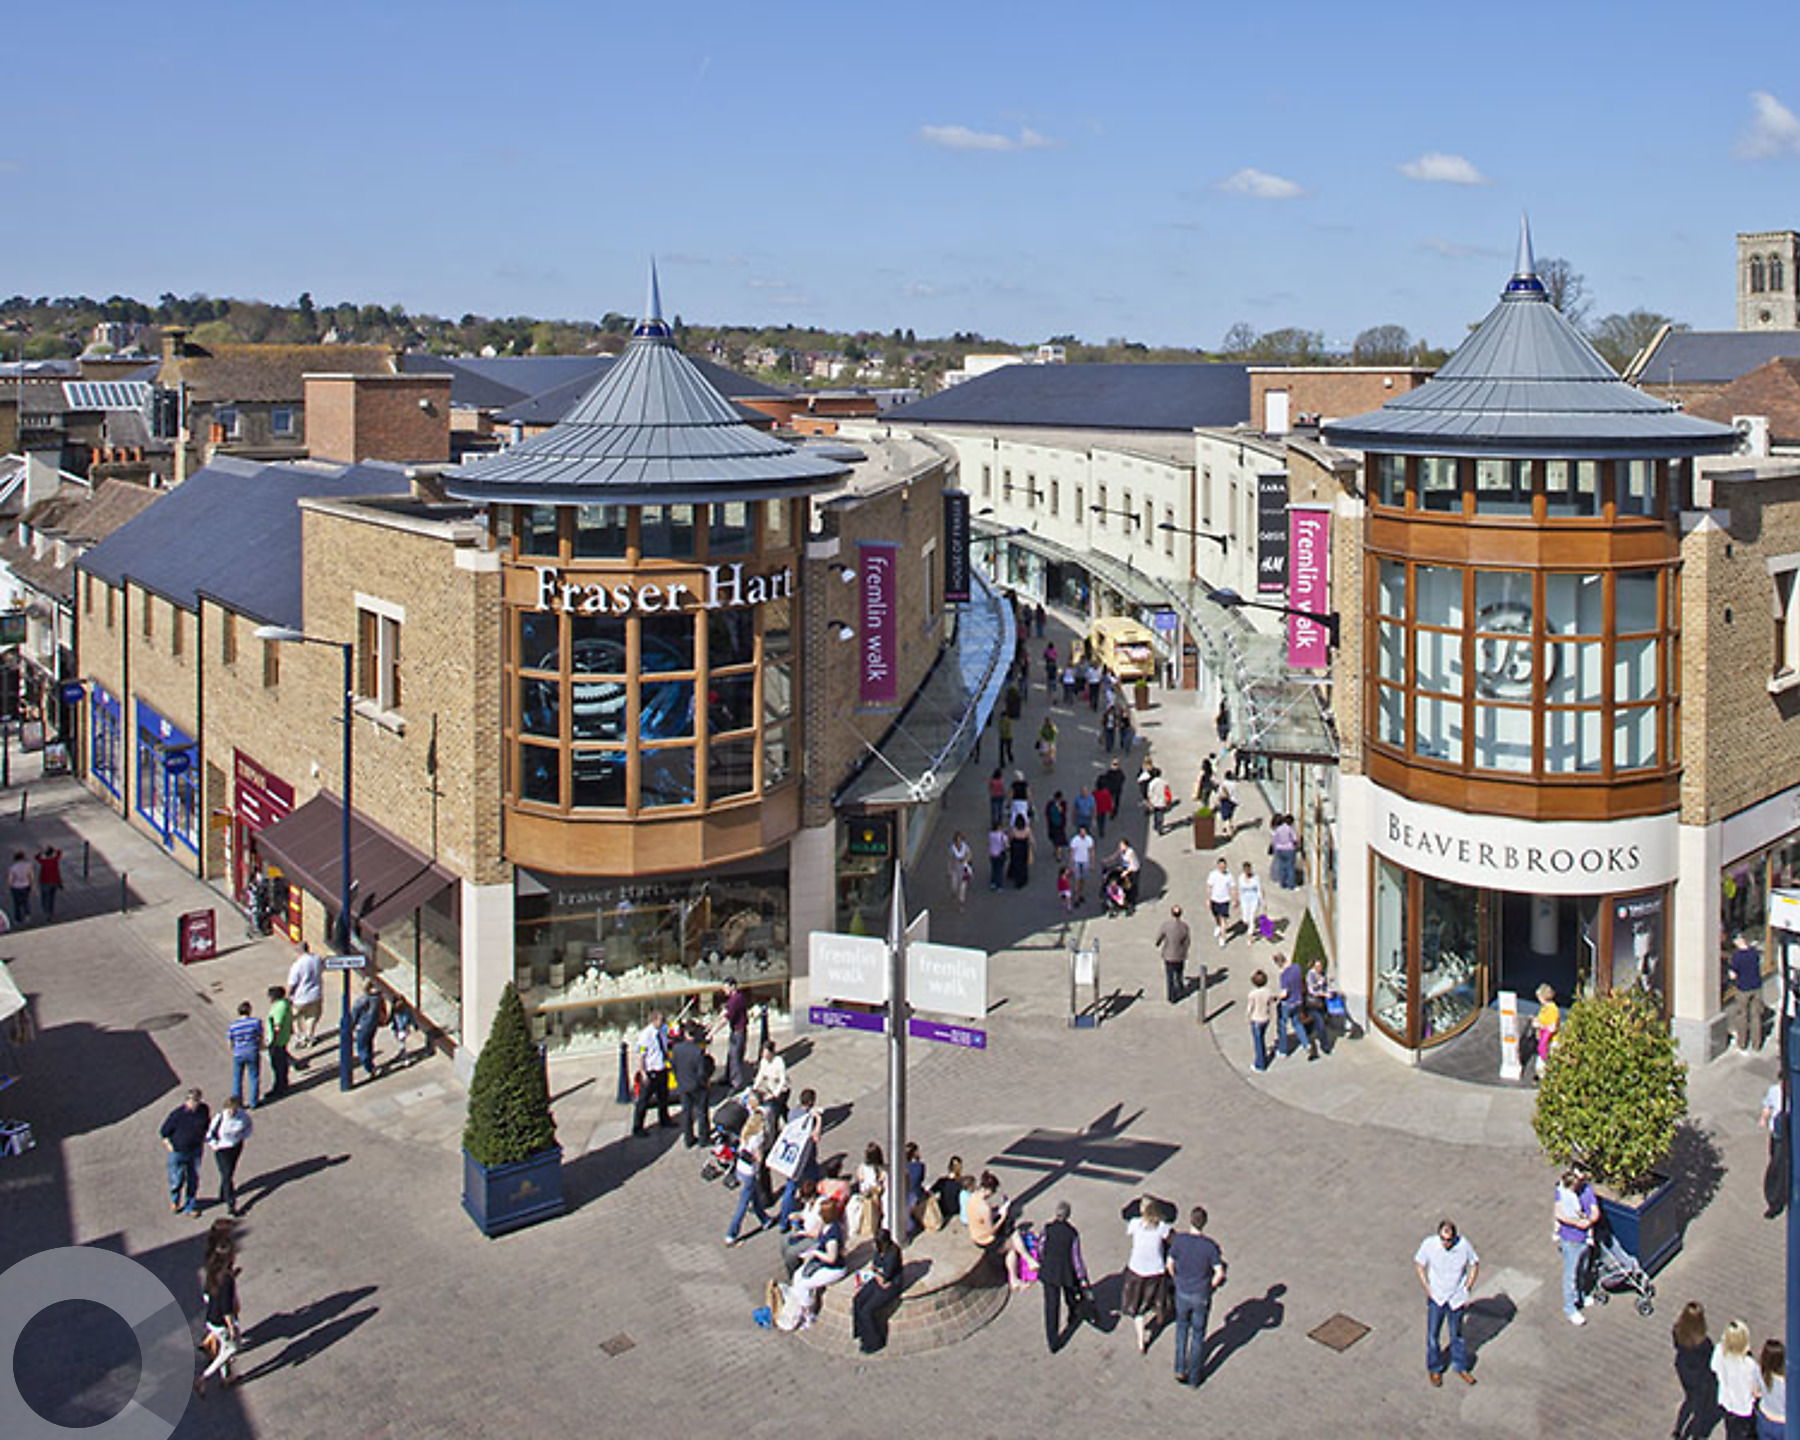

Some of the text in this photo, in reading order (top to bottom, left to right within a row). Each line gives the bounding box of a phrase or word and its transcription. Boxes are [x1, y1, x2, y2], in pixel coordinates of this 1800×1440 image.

[1297, 519, 1320, 593] fremlin
[534, 563, 793, 613] Fraser Hart
[866, 556, 888, 682] fremlin walk
[1387, 812, 1641, 874] BEAVERBROOKS
[819, 943, 876, 966] fremlin
[919, 954, 977, 980] fremlin
[827, 967, 865, 984] walk
[927, 978, 967, 998] walk
